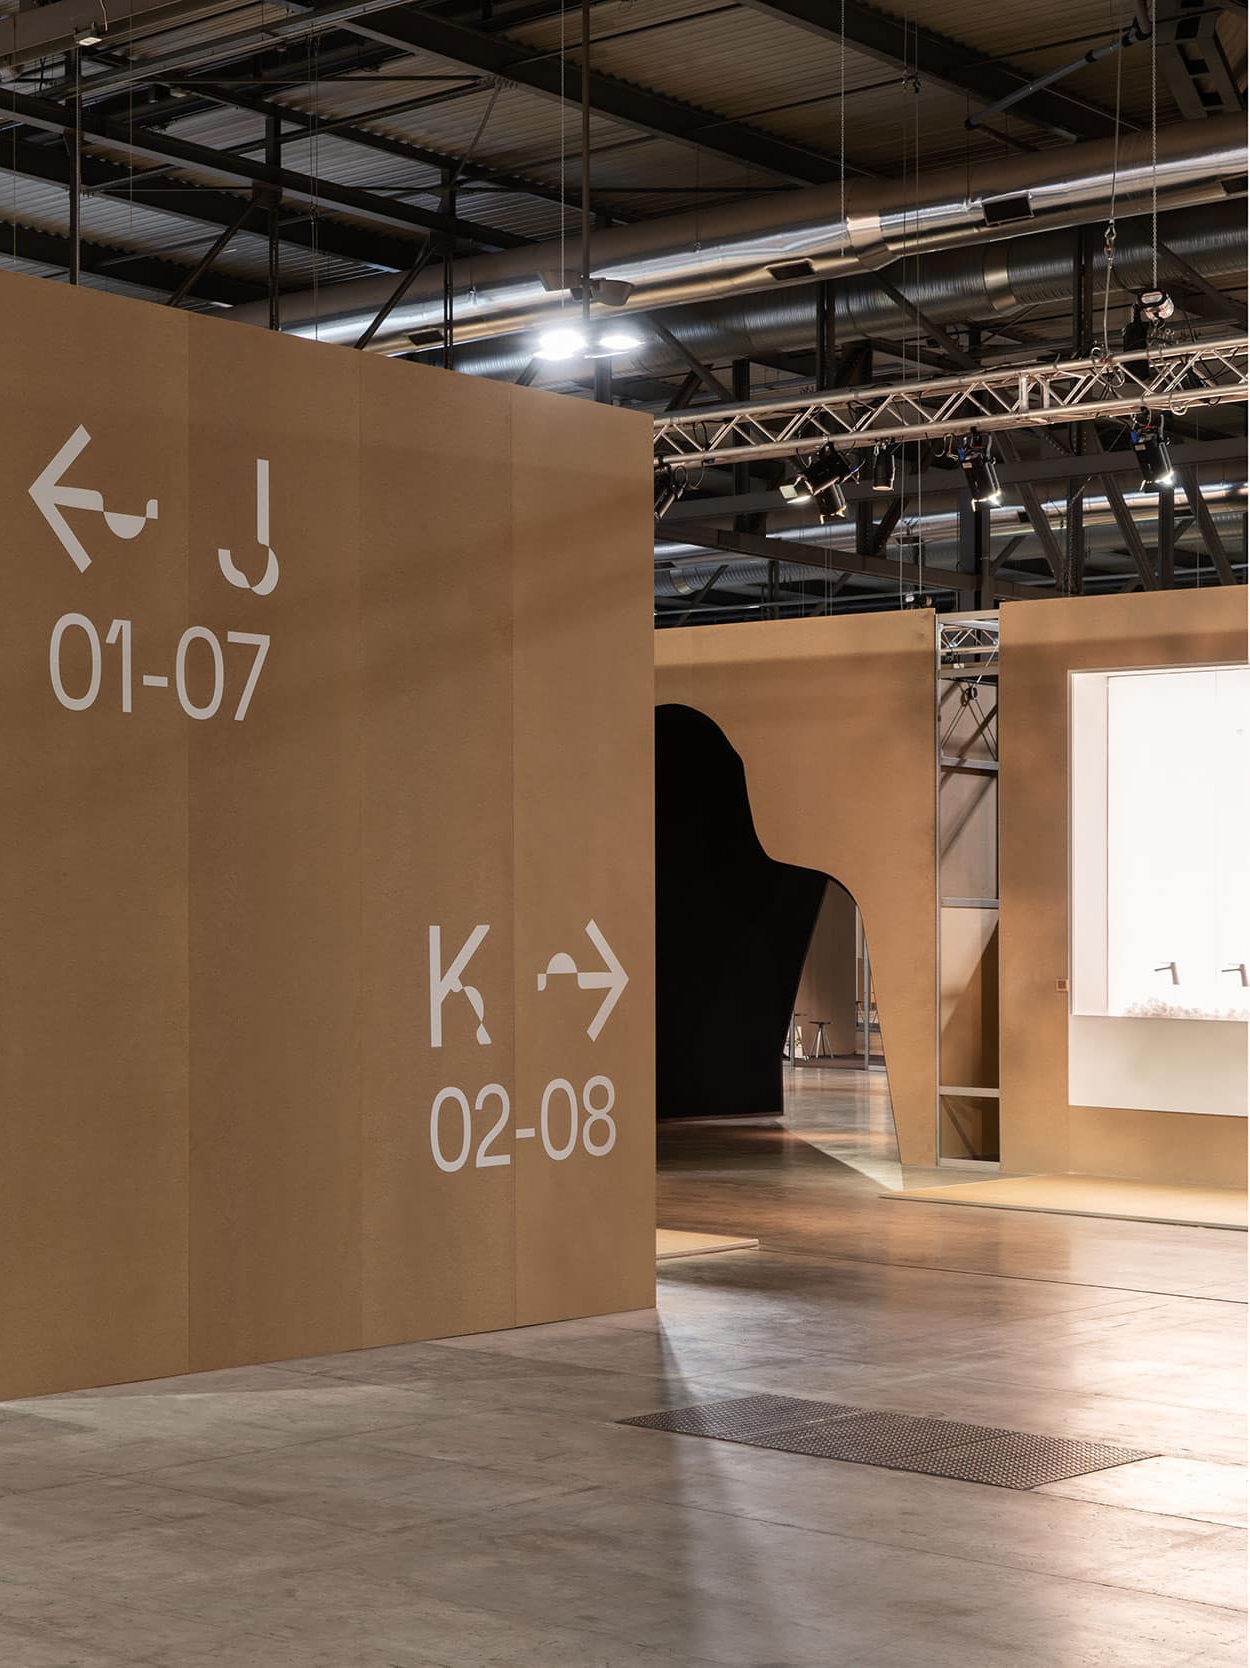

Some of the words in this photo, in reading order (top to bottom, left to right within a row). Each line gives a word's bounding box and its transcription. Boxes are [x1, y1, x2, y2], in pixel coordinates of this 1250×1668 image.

[217, 458, 279, 596] J
[49, 612, 271, 721] 01-07
[429, 924, 492, 1048] K
[430, 1075, 616, 1172] 02-08
